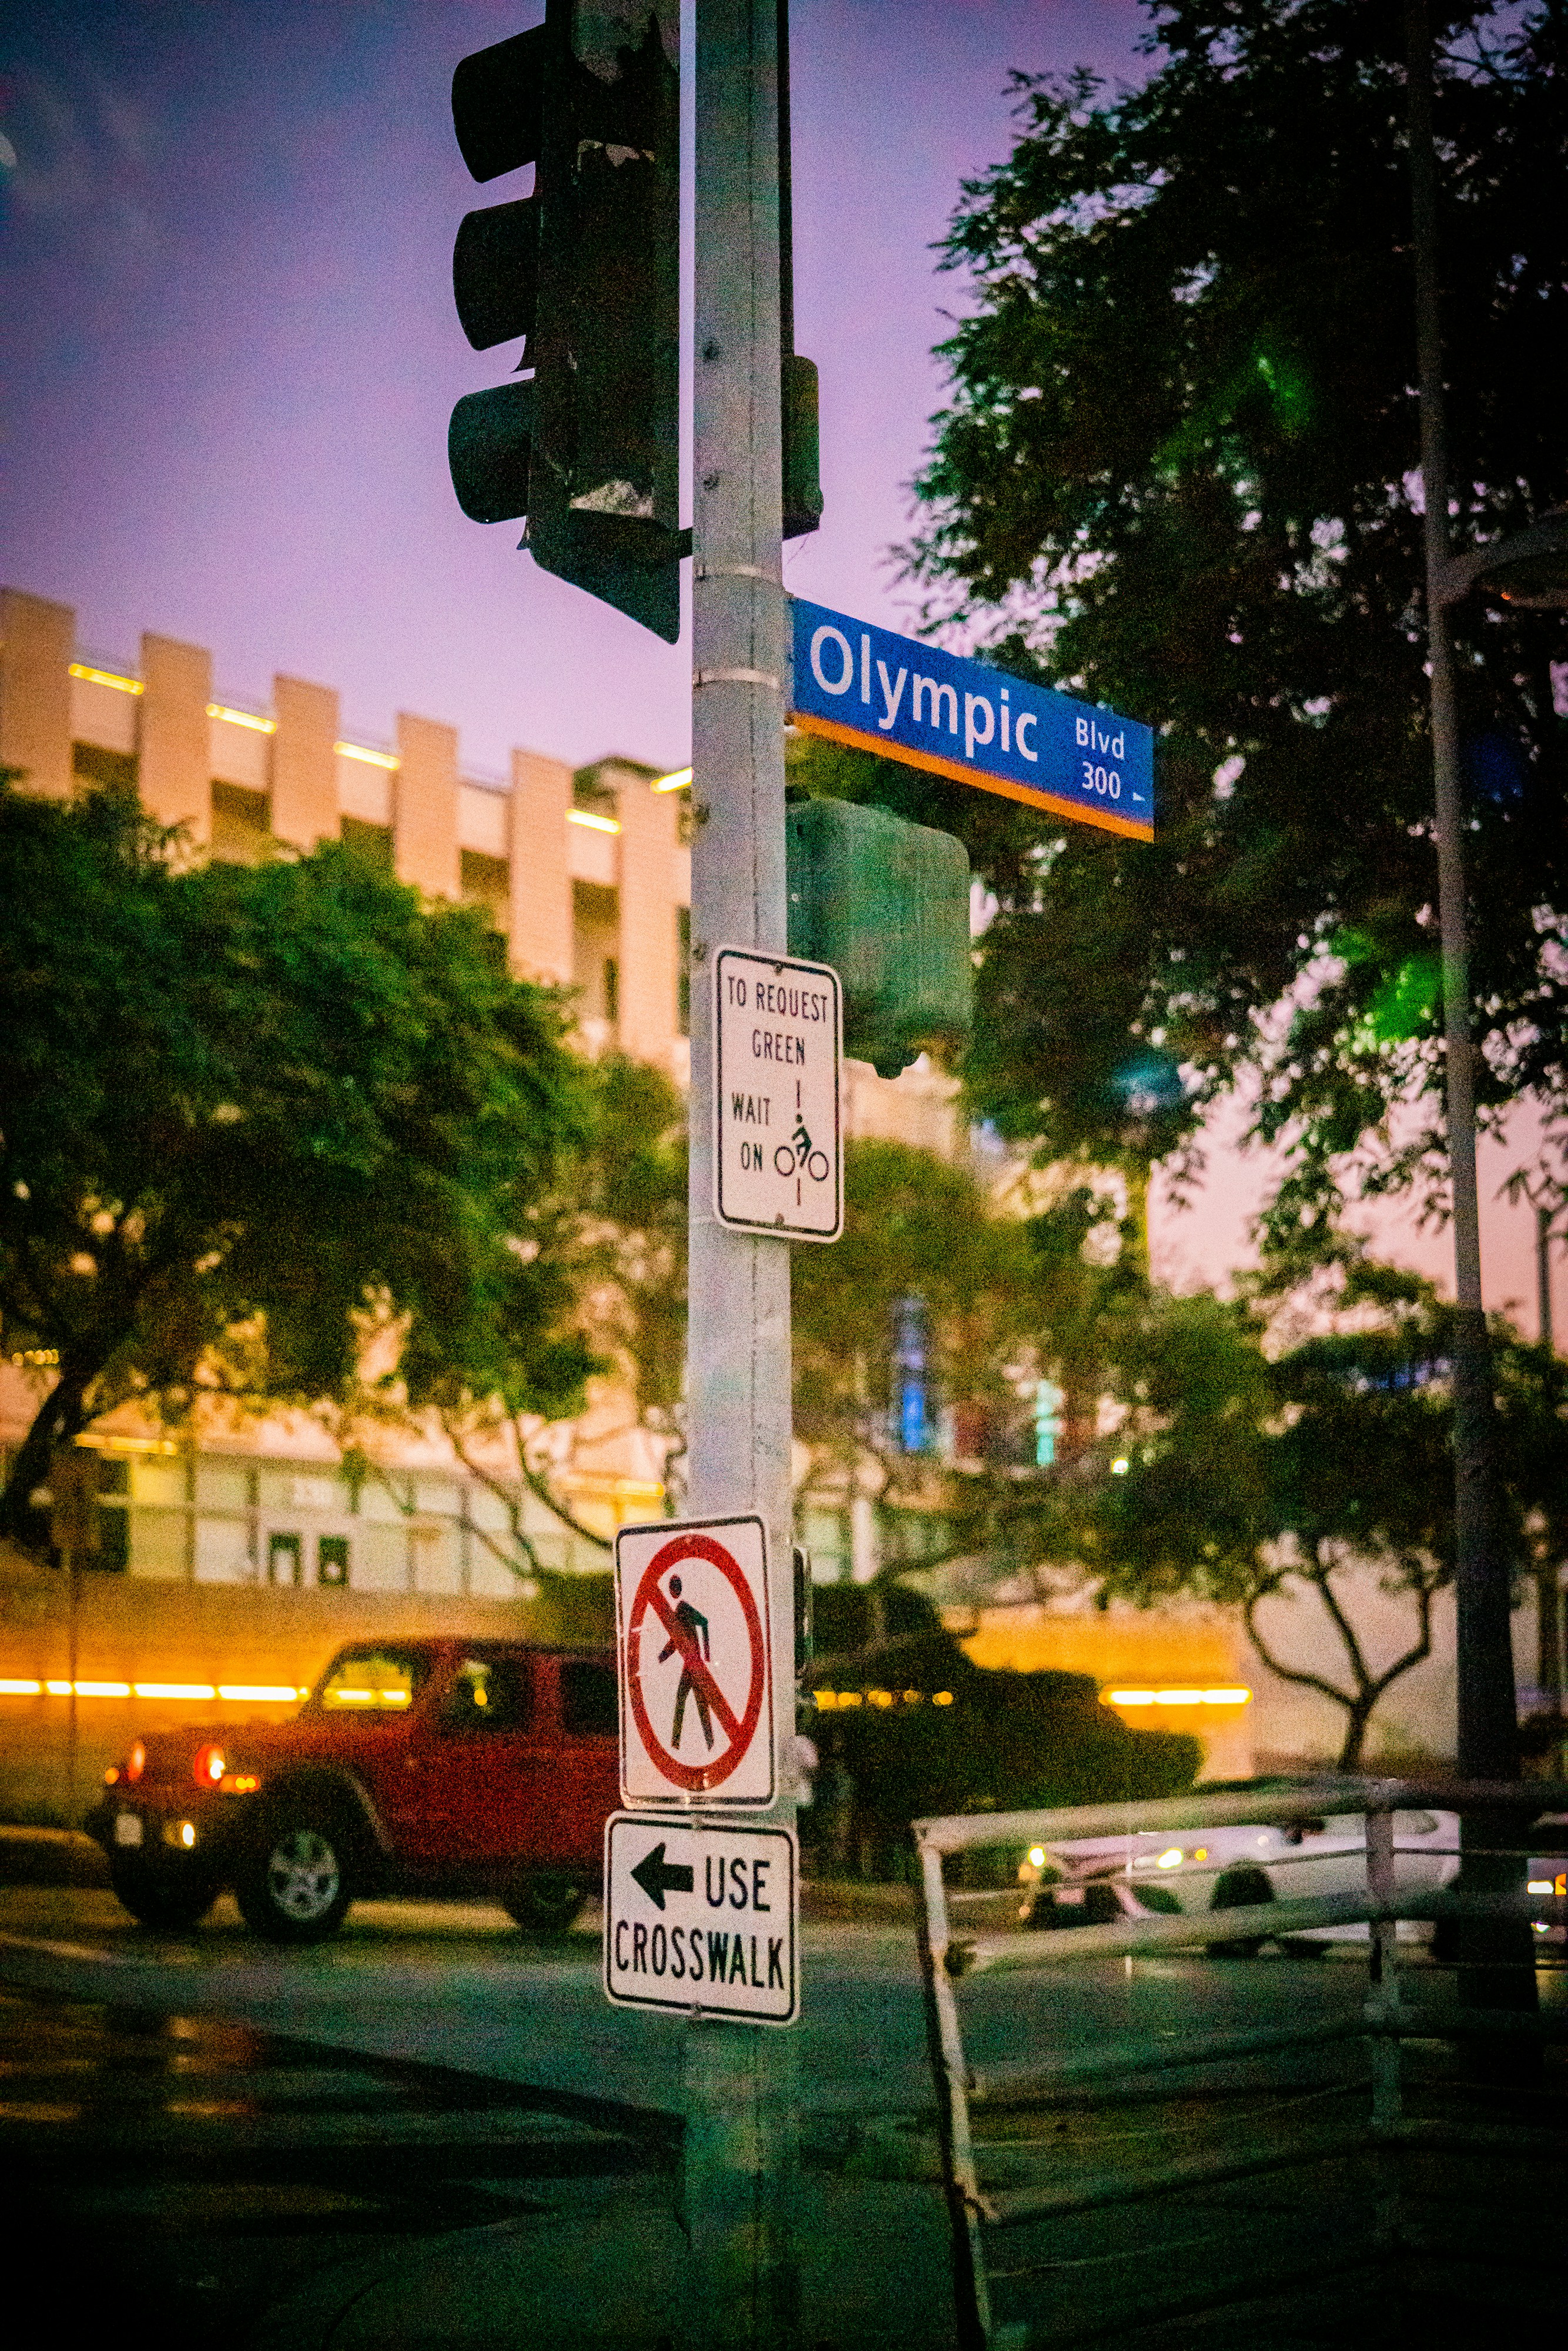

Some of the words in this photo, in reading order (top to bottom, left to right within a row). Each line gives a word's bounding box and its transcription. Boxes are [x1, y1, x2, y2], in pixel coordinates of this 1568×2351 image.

[810, 625, 1038, 762] Olympic
[1076, 716, 1125, 760] Blvd
[1081, 761, 1121, 799] 300
[727, 975, 747, 1006] TO
[756, 982, 828, 1023] REQUEST
[752, 1029, 805, 1066] GREEN
[731, 1092, 771, 1126] WAIT
[741, 1141, 763, 1173] ON
[705, 1854, 770, 1913] USE
[615, 1919, 785, 1990] CROSSWALK
